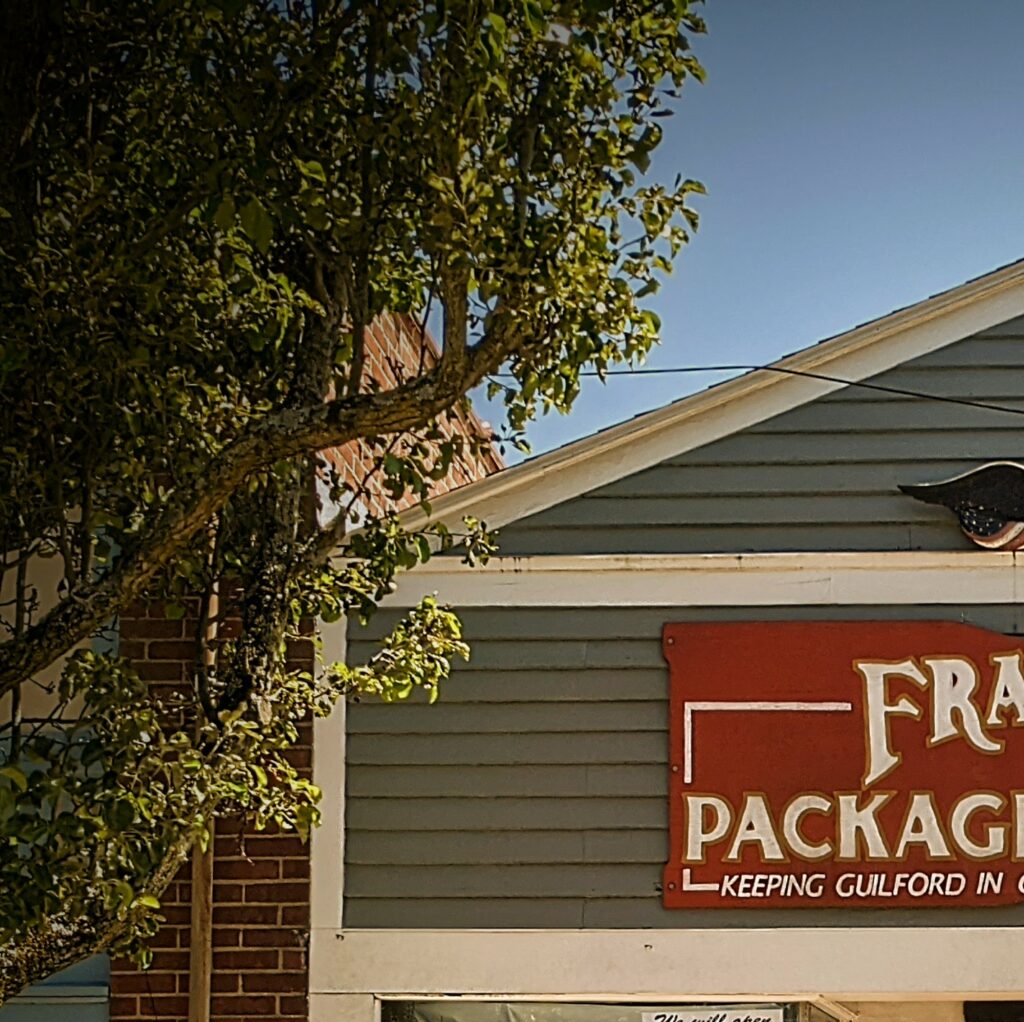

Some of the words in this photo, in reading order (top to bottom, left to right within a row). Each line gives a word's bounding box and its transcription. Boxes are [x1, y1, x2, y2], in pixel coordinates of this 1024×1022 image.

[720, 873, 824, 898] KEEPING
[836, 873, 962, 897] GUILFORD
[975, 872, 1003, 896] IN
